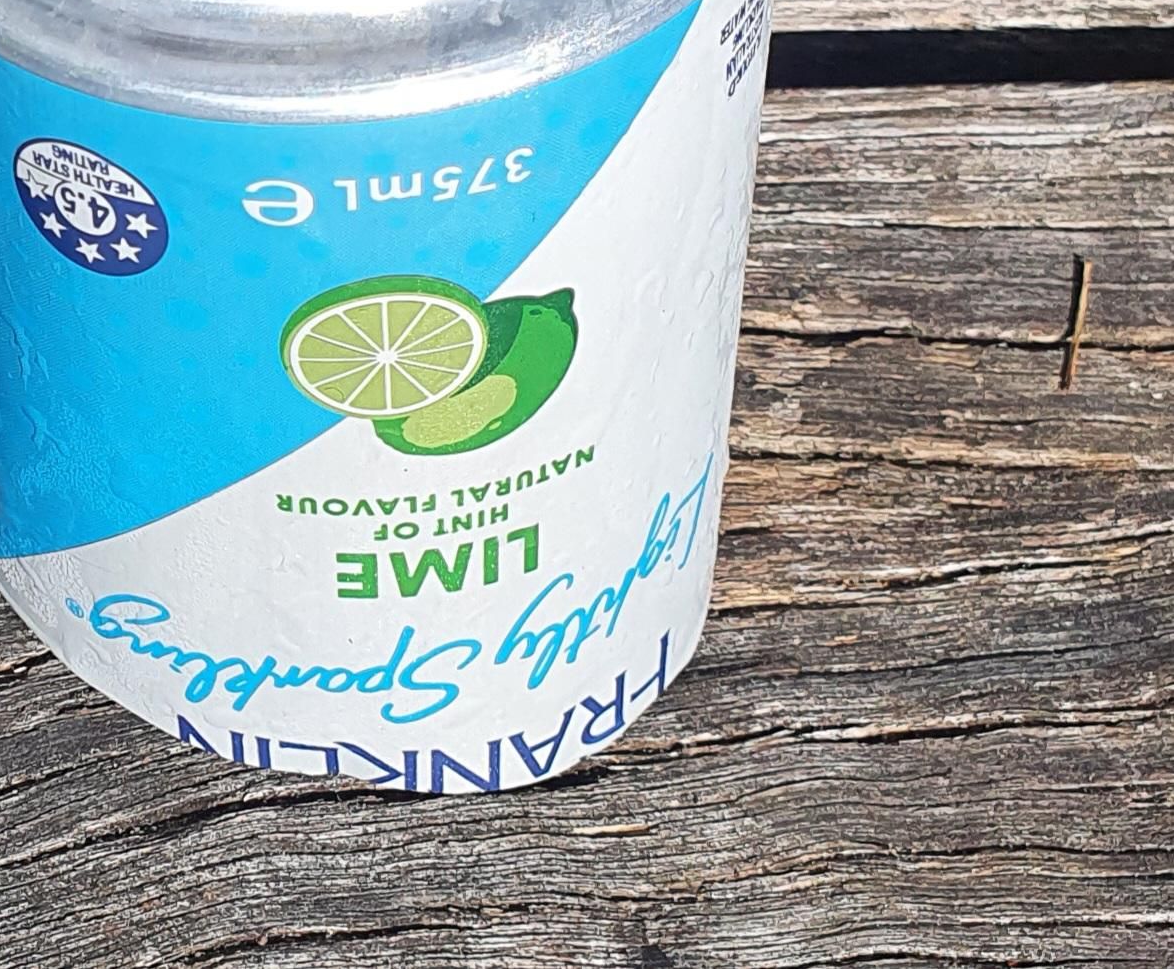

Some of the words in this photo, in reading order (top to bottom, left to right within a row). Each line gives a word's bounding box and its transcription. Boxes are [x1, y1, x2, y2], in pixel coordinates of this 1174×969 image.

[32, 150, 71, 179] STAR
[51, 143, 110, 176] RATING
[73, 167, 136, 198] HEALTH
[333, 146, 534, 212] 375mL
[60, 187, 111, 229] 4.5
[450, 444, 596, 507] NATURAL
[275, 492, 437, 517] FLAVOUR
[432, 502, 510, 538] HINT
[372, 520, 421, 542] OF
[335, 521, 540, 600] LIME
[493, 451, 715, 691] Lightly
